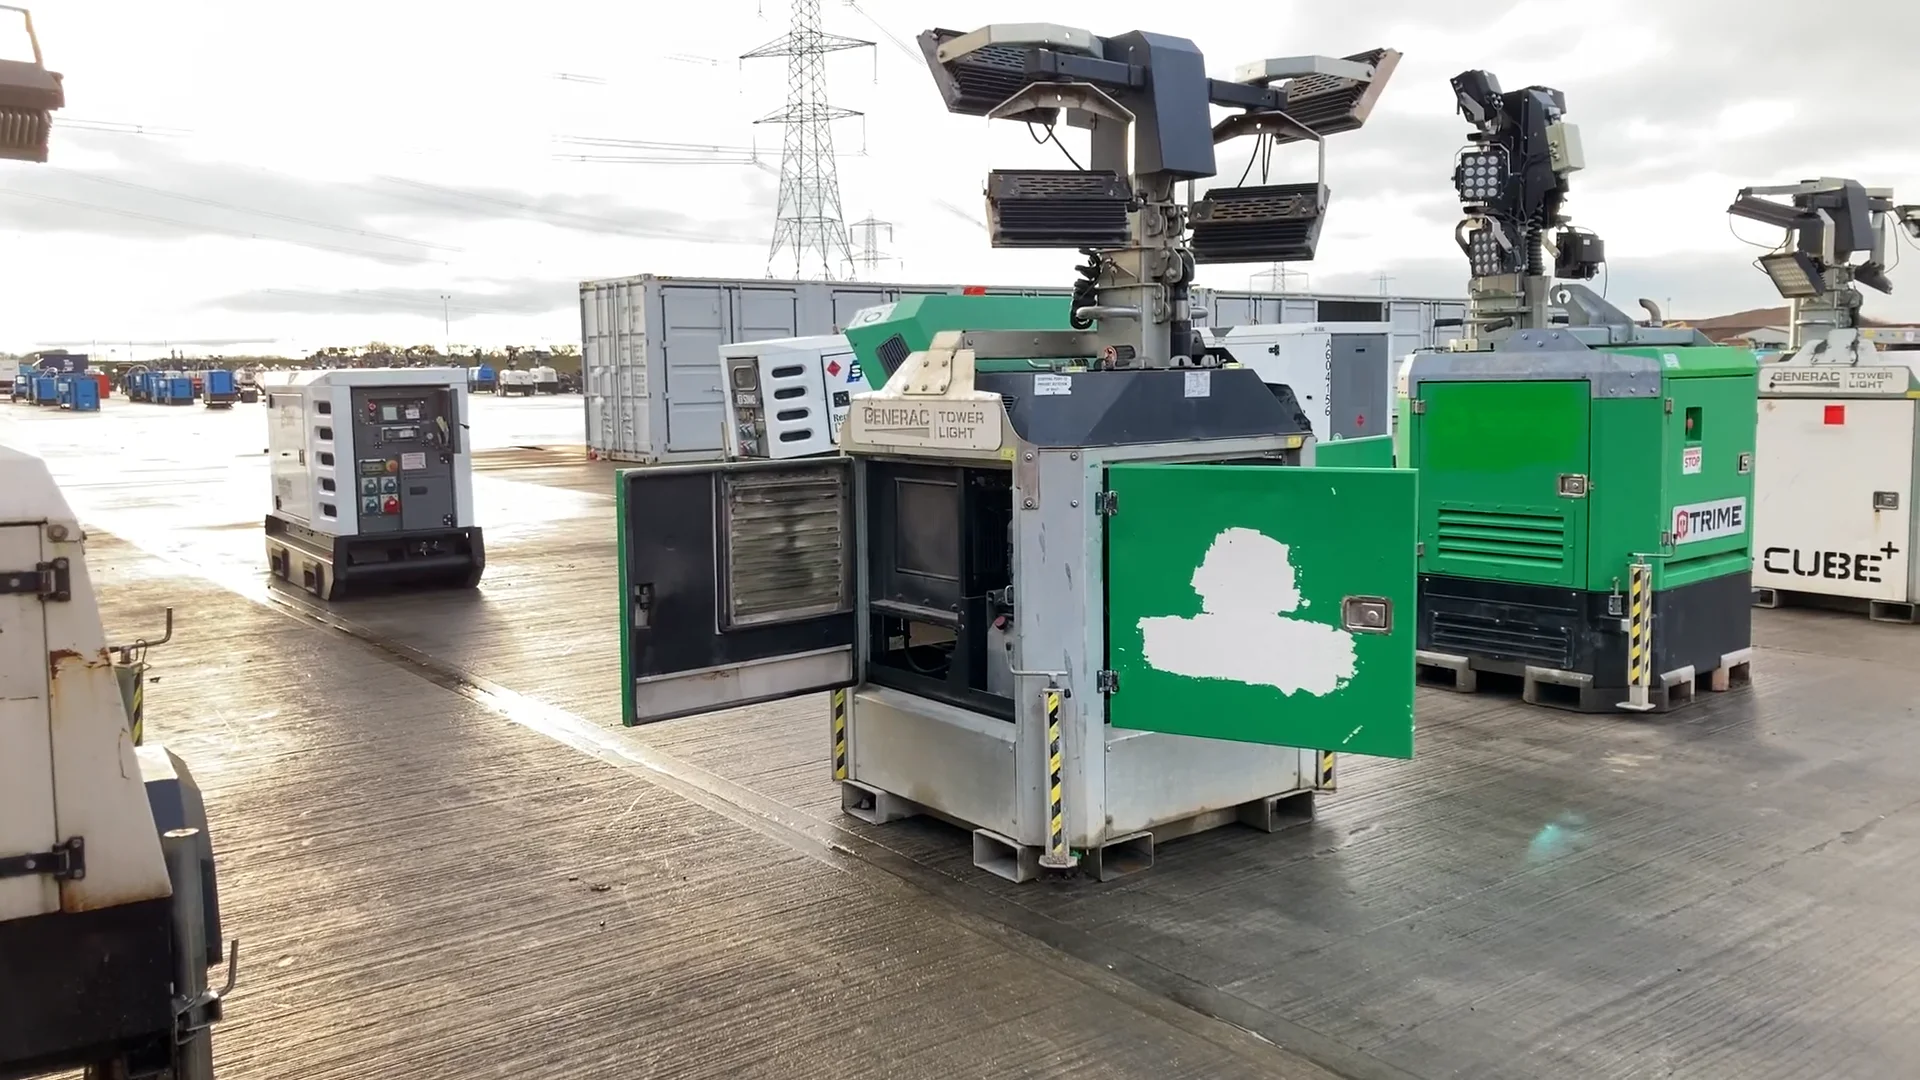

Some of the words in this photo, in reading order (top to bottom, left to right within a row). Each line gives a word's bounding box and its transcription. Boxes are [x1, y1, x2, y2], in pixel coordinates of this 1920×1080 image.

[1772, 371, 1841, 382] GENERAC
[1849, 372, 1893, 380] TOWER
[1849, 380, 1884, 389] LIGHT
[938, 411, 985, 424] TOWER
[938, 427, 976, 440] LIGHT
[1684, 455, 1701, 469] STOP
[1689, 505, 1743, 534] TRIME
